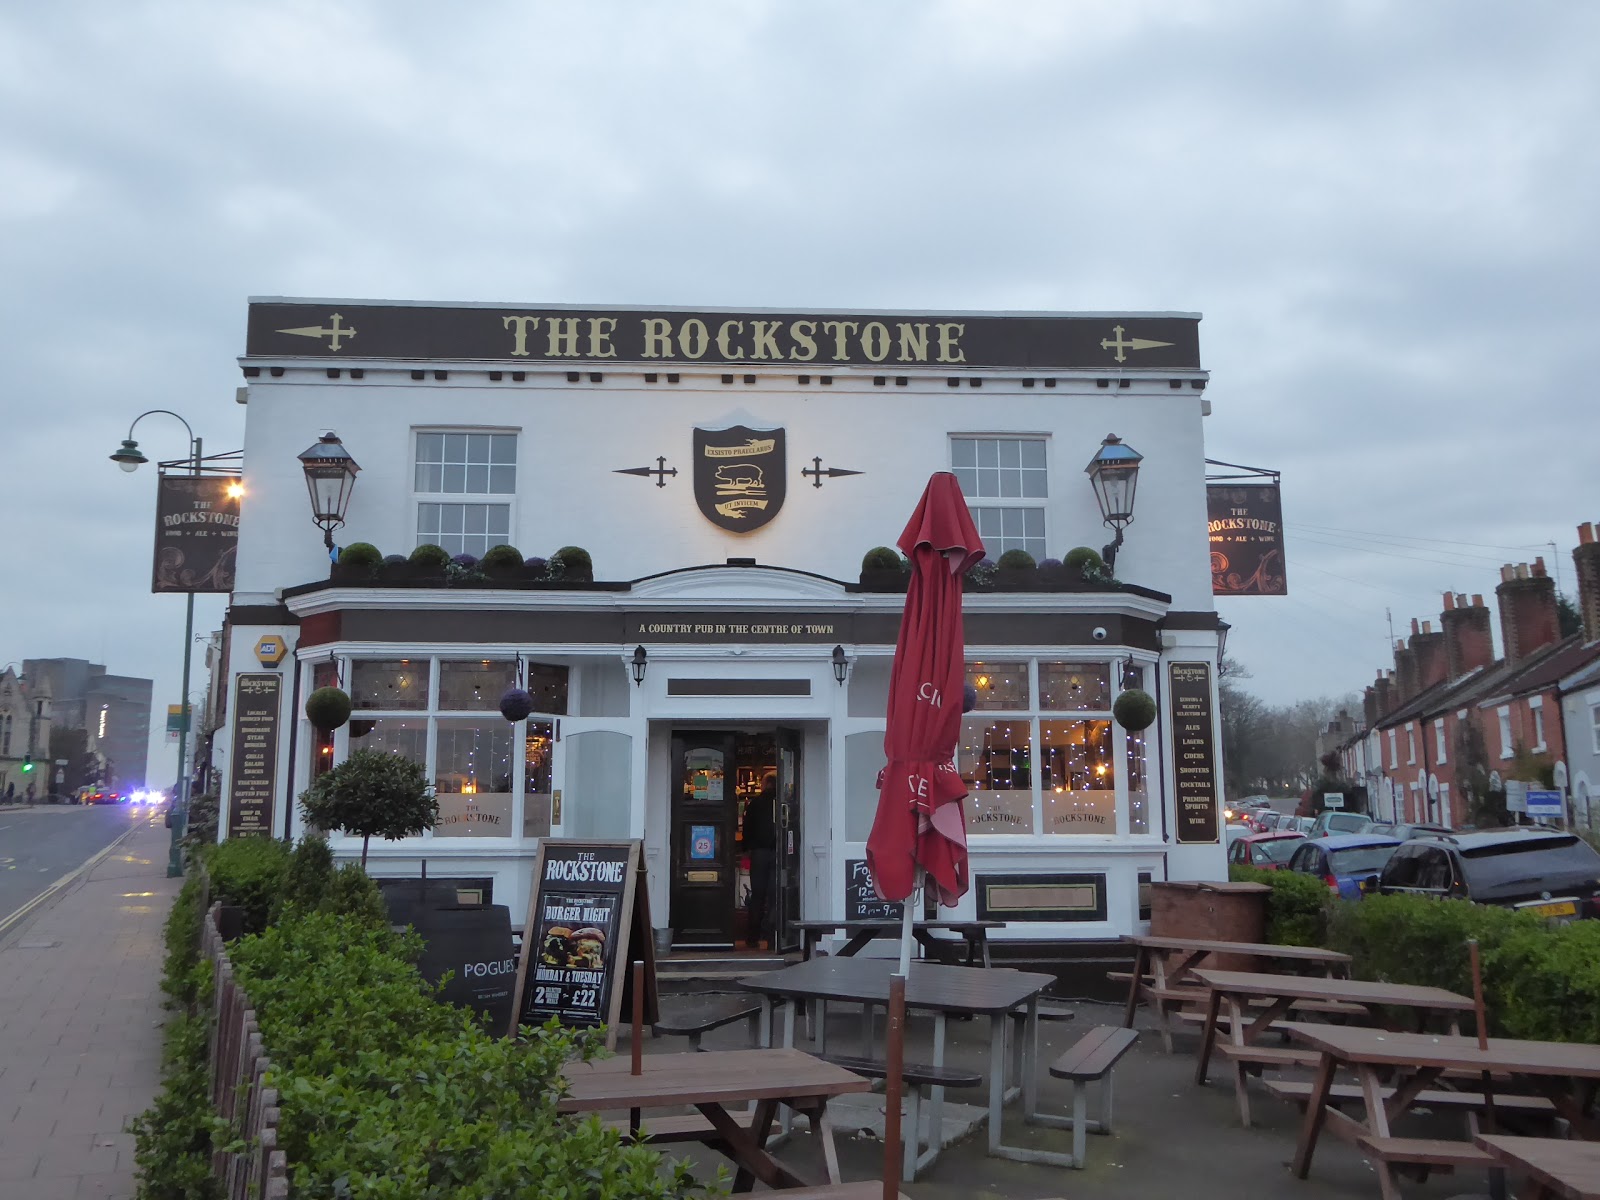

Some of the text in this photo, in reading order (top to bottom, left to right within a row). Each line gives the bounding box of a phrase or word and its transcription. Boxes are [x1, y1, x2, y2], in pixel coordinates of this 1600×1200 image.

[503, 316, 967, 363] THE ROCKSTONE
[193, 501, 212, 509] THE
[1230, 508, 1248, 516] THE
[164, 512, 240, 528] ROCKSTONE
[1208, 517, 1276, 533] ROCKSTONE
[639, 624, 833, 634] A COUNTRY PUB IN THE CENTRE OF TOWN
[261, 644, 276, 654] ADT
[698, 842, 709, 850] 25
[545, 860, 624, 882] ROCKSTONE
[545, 906, 611, 922] BURGER NIGHT
[464, 959, 514, 978] POGUES
[536, 968, 604, 984] MONDAY & TUESDAY
[534, 986, 545, 1004] 2
[571, 989, 596, 1007] £22
